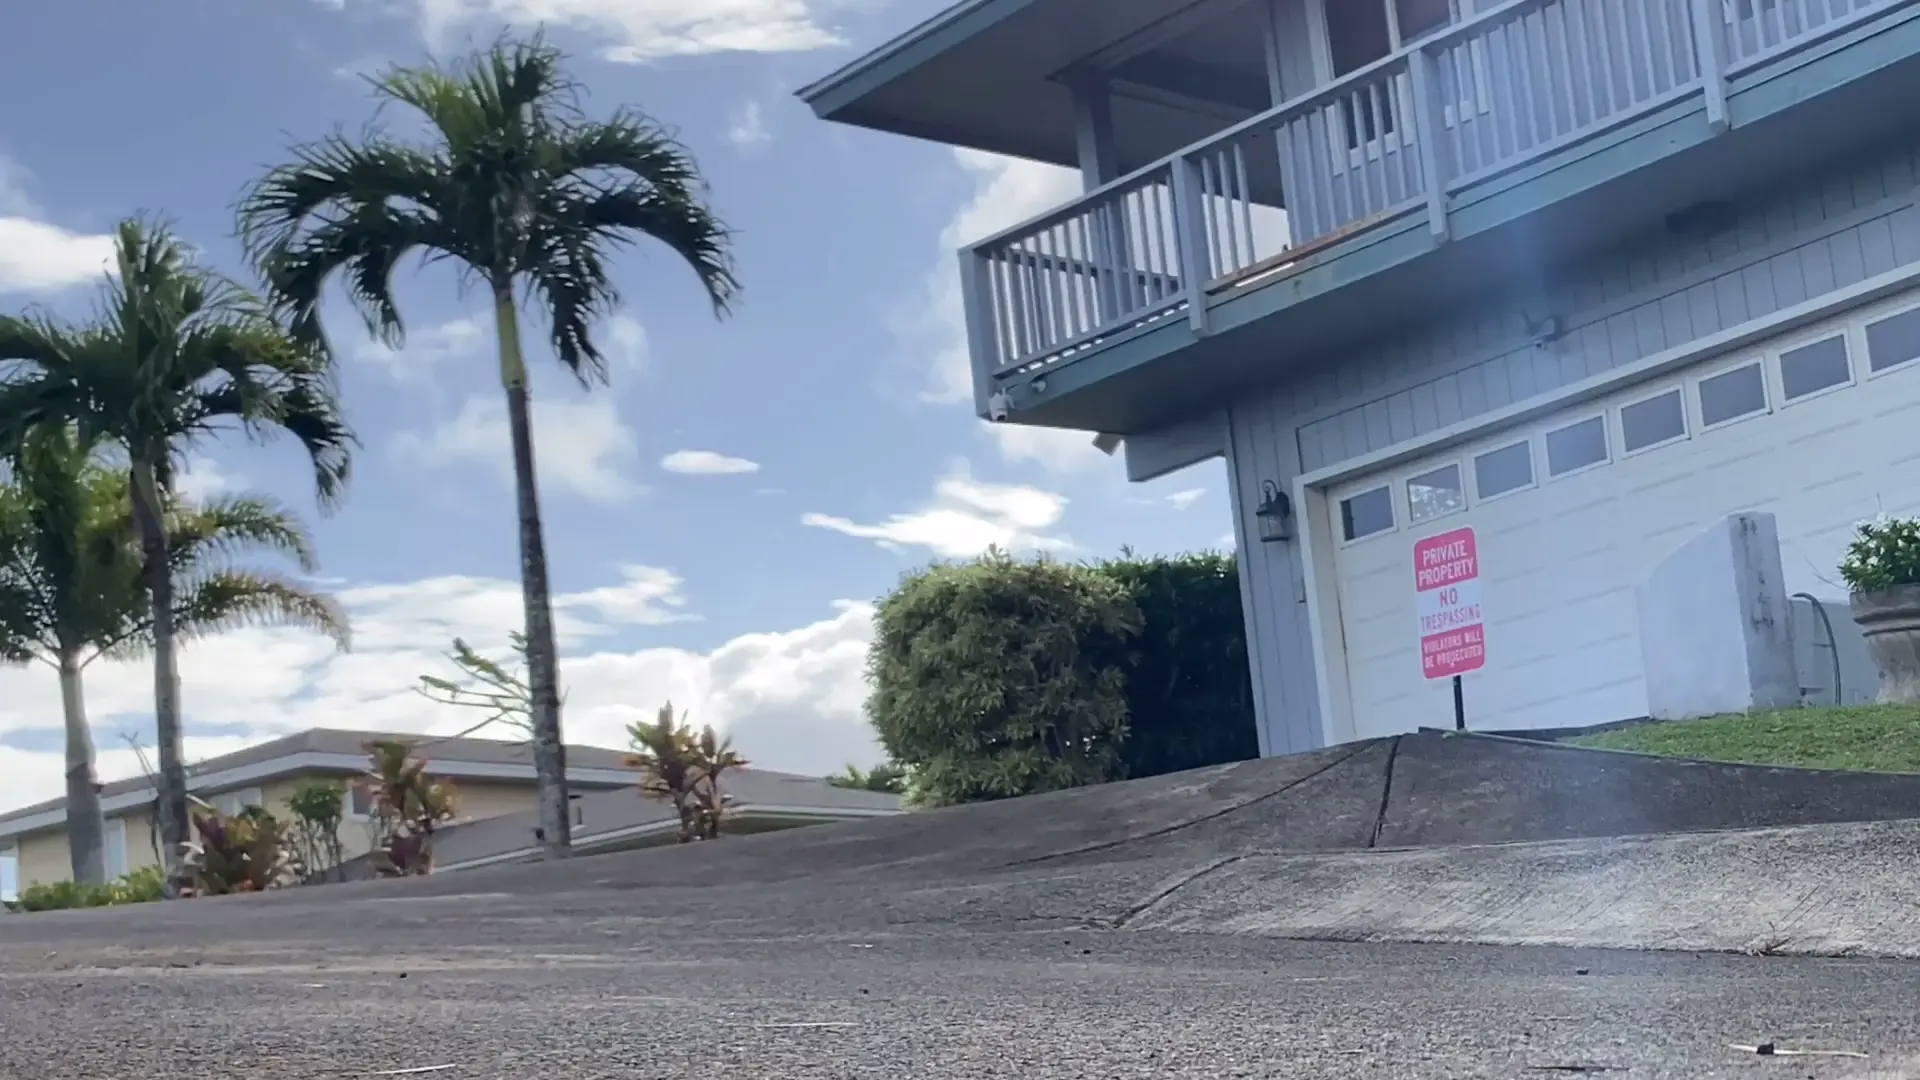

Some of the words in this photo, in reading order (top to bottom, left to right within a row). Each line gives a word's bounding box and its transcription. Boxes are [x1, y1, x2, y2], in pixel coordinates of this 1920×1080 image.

[1423, 540, 1467, 566] PRIVATE
[1419, 557, 1473, 587] PROPERTY
[1440, 588, 1457, 608] NO
[1421, 603, 1480, 632] TRESPASSING
